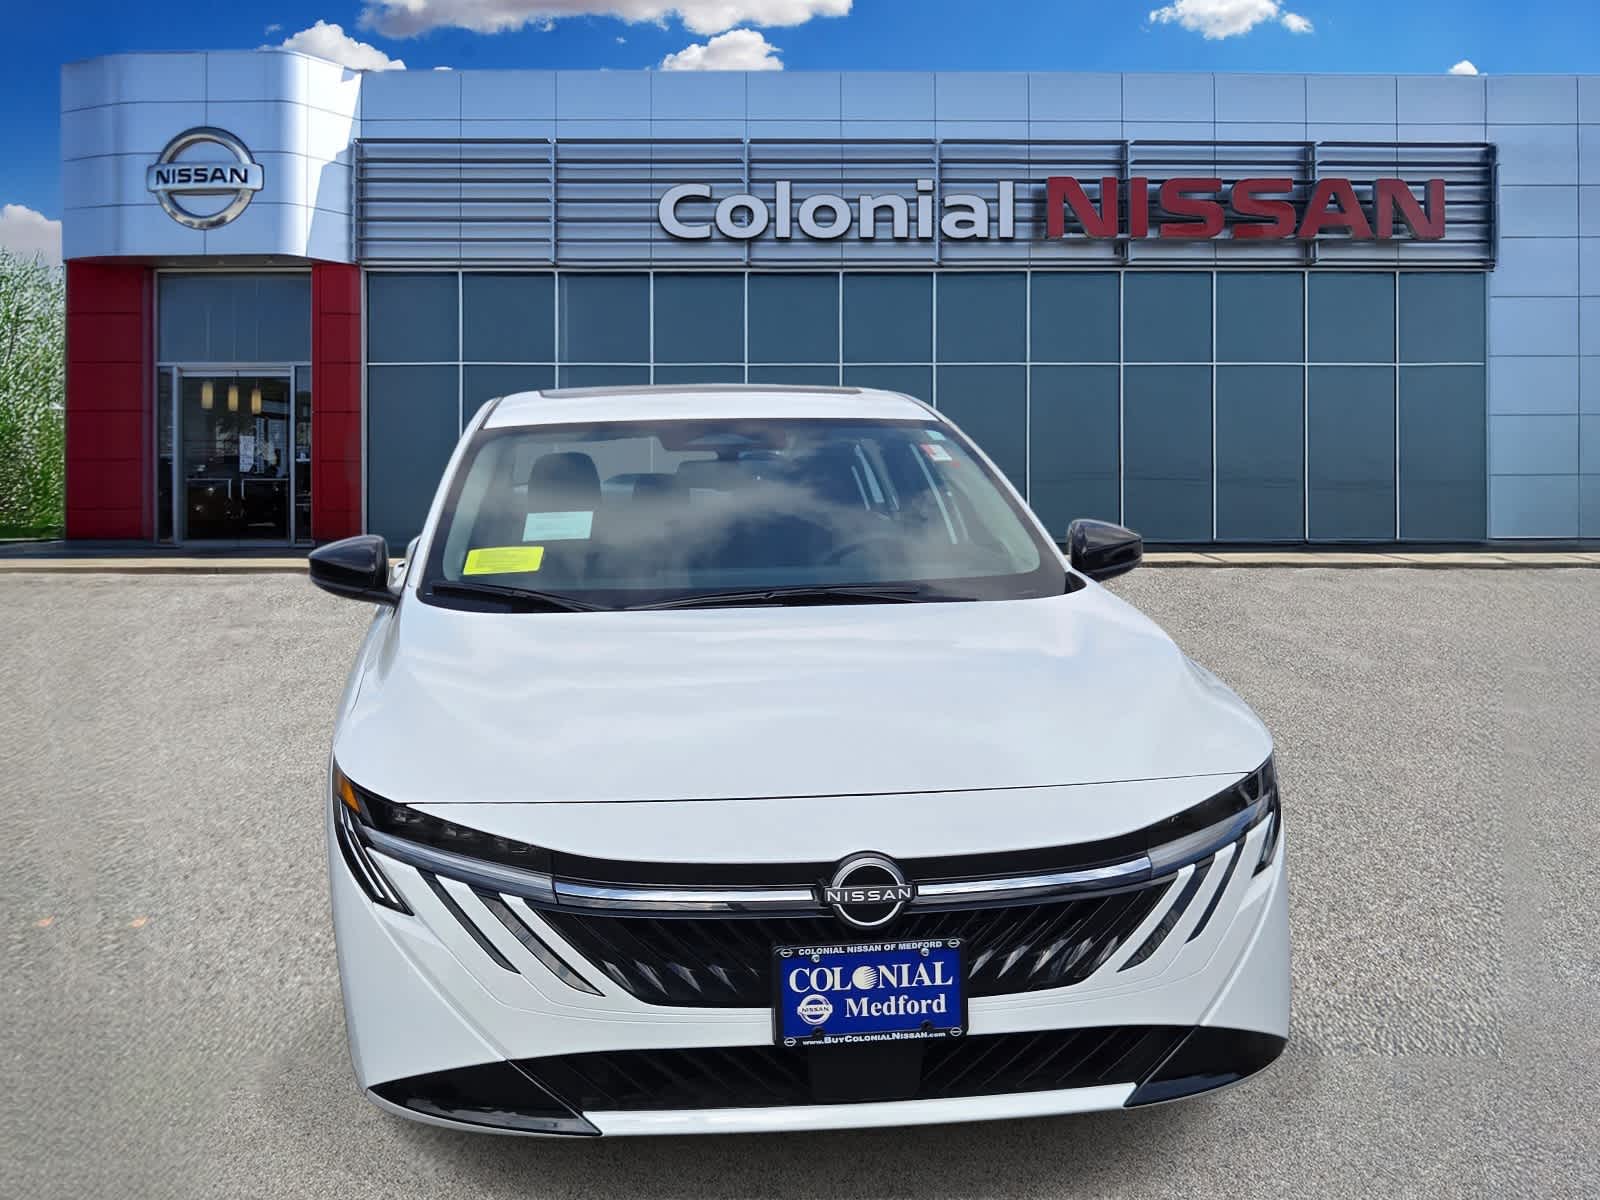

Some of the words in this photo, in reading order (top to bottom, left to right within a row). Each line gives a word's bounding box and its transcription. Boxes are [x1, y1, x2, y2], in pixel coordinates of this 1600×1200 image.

[155, 167, 248, 185] NISSAN
[658, 179, 1015, 240] Colonial
[1046, 176, 1446, 240] NISSAN
[827, 887, 911, 902] NISSAN
[798, 947, 845, 956] COLONIAL
[847, 944, 882, 953] NISSAN
[884, 943, 896, 951] OF
[898, 941, 942, 950] MEDFORD
[788, 961, 953, 993] COLONIAL
[801, 1006, 830, 1014] NISSAN
[845, 993, 947, 1018] Medford
